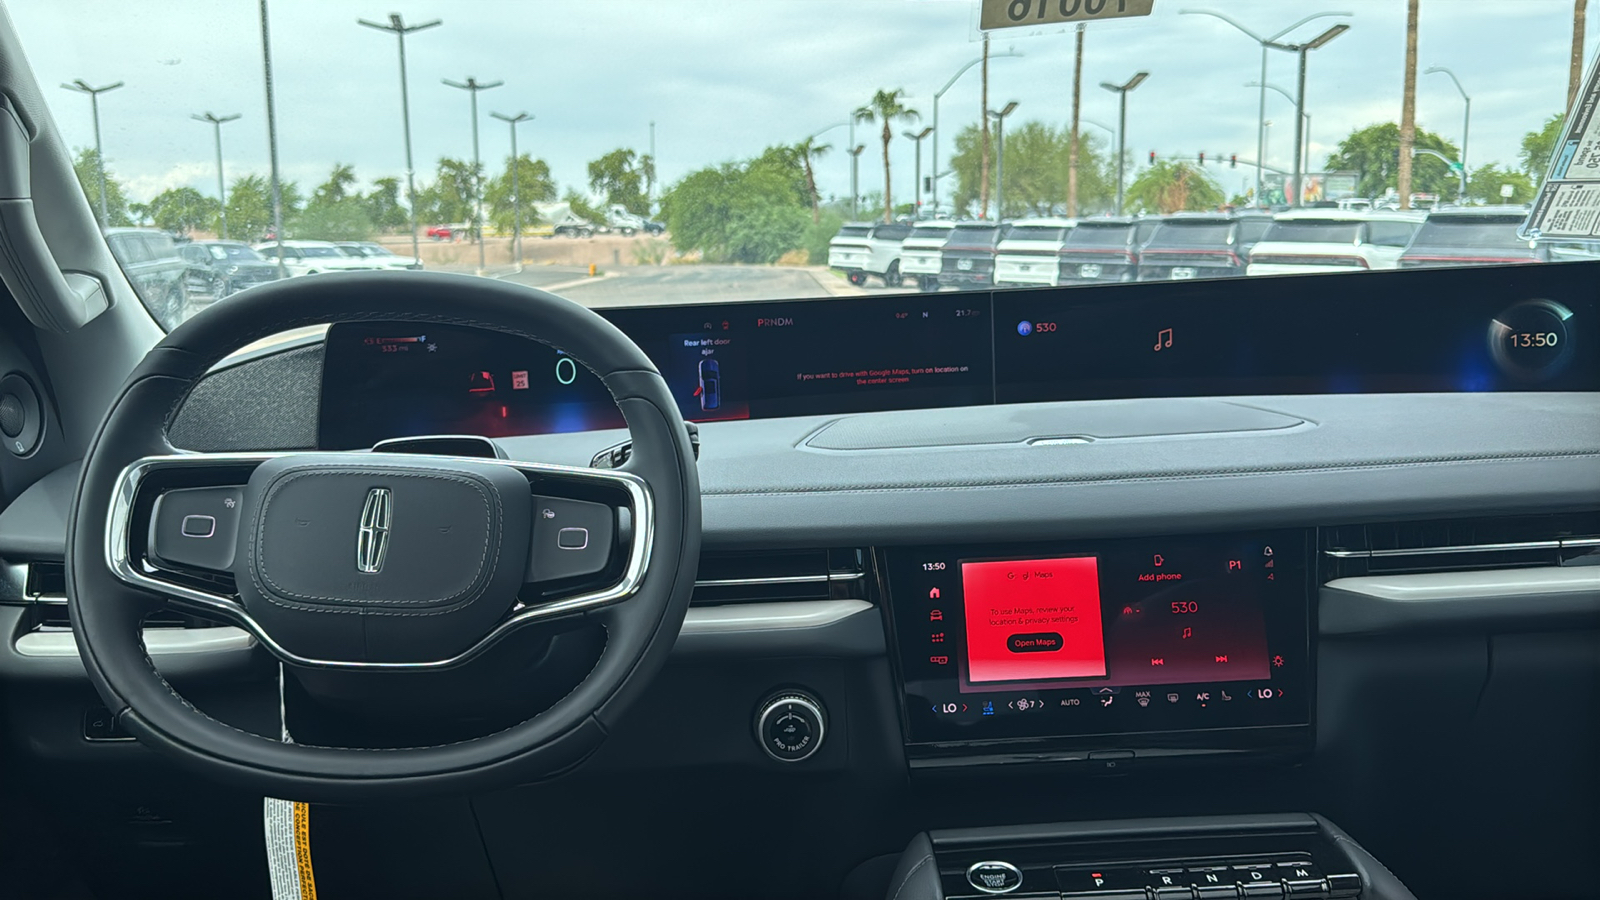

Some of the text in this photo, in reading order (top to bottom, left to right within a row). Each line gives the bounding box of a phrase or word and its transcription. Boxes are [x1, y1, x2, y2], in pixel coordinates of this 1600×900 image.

[1036, 322, 1057, 332] 530
[1510, 332, 1558, 348] 13:50
[702, 348, 714, 356] ajar
[556, 358, 576, 384] 0
[922, 562, 946, 571] 13:50
[1228, 560, 1242, 570] P1
[1007, 572, 1032, 580] Ggl
[1156, 573, 1182, 582] phone
[1059, 606, 1074, 614] your
[1171, 601, 1198, 614] 530
[1025, 617, 1050, 626] privacy
[1051, 615, 1078, 624] settings
[1014, 638, 1056, 648] Open Maps
[1196, 692, 1210, 700] A/C
[1257, 688, 1273, 698] LO
[942, 703, 958, 713] LO
[773, 735, 810, 752] PRO TRAILER
[296, 813, 304, 864] CONCEPTION
[306, 870, 312, 881] DE
[1251, 871, 1262, 880] D
[1296, 868, 1309, 877] M
[1094, 878, 1104, 887] P
[1162, 876, 1173, 885] R
[1206, 874, 1218, 883] N
